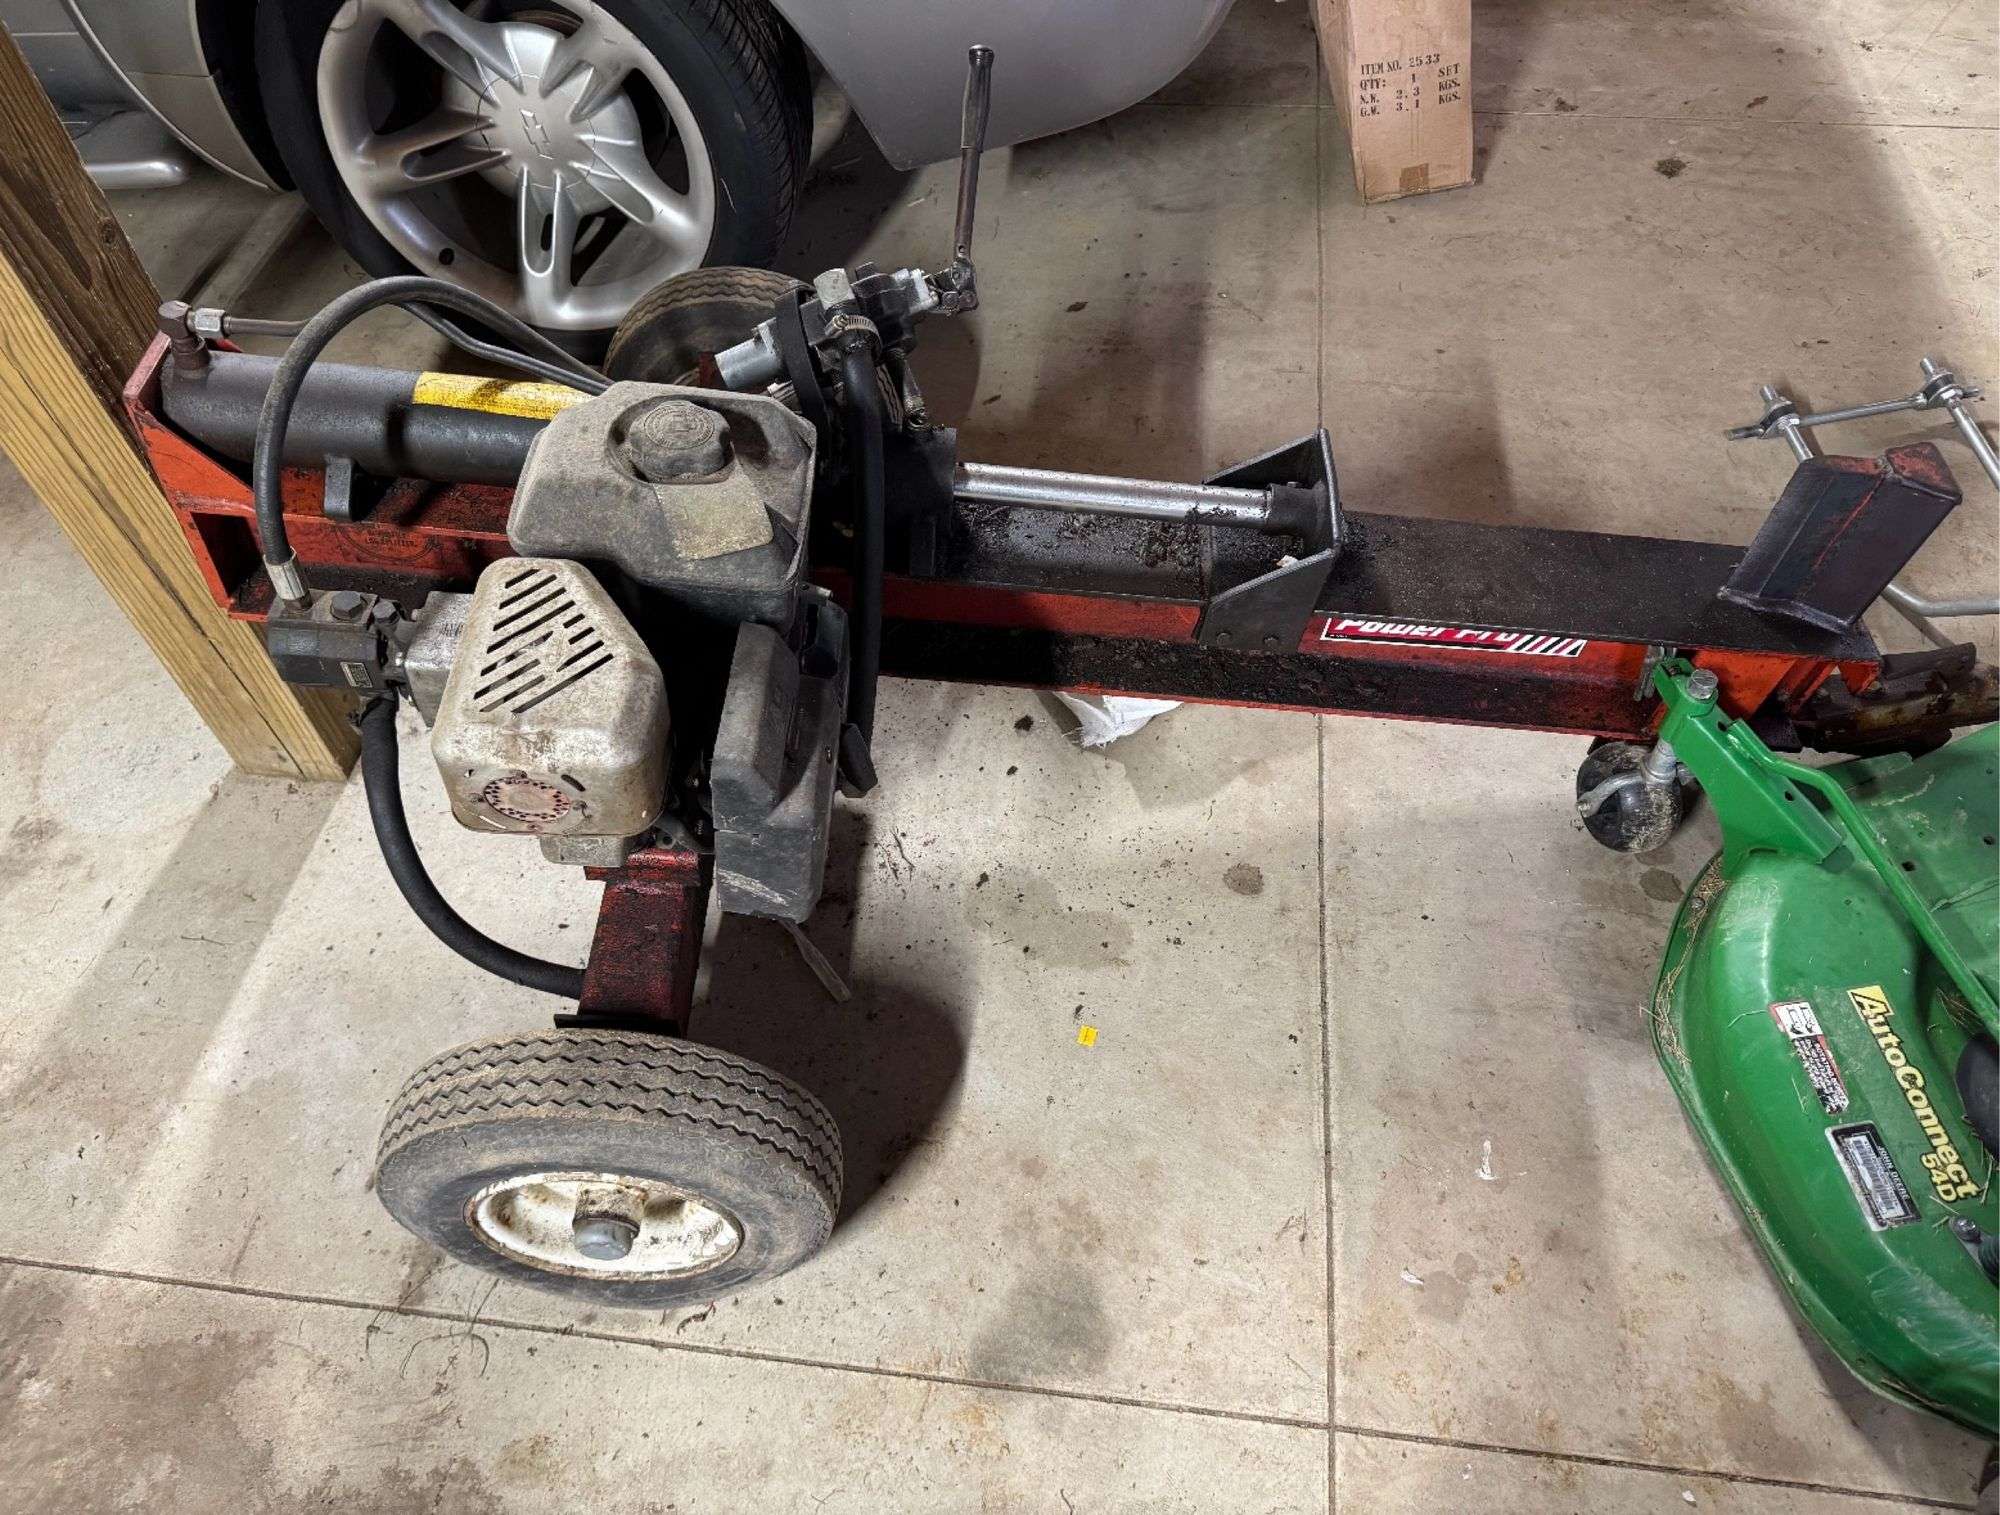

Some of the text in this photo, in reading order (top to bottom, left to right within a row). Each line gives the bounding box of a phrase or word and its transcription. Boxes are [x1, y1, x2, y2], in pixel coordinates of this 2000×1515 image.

[1361, 54, 1440, 75] ITEM NO. 2533
[1360, 63, 1461, 90] QTY: 1 SET
[1438, 78, 1461, 91] KGS.
[1438, 91, 1461, 105] KGS.
[1920, 1152, 1957, 1202] 54D
